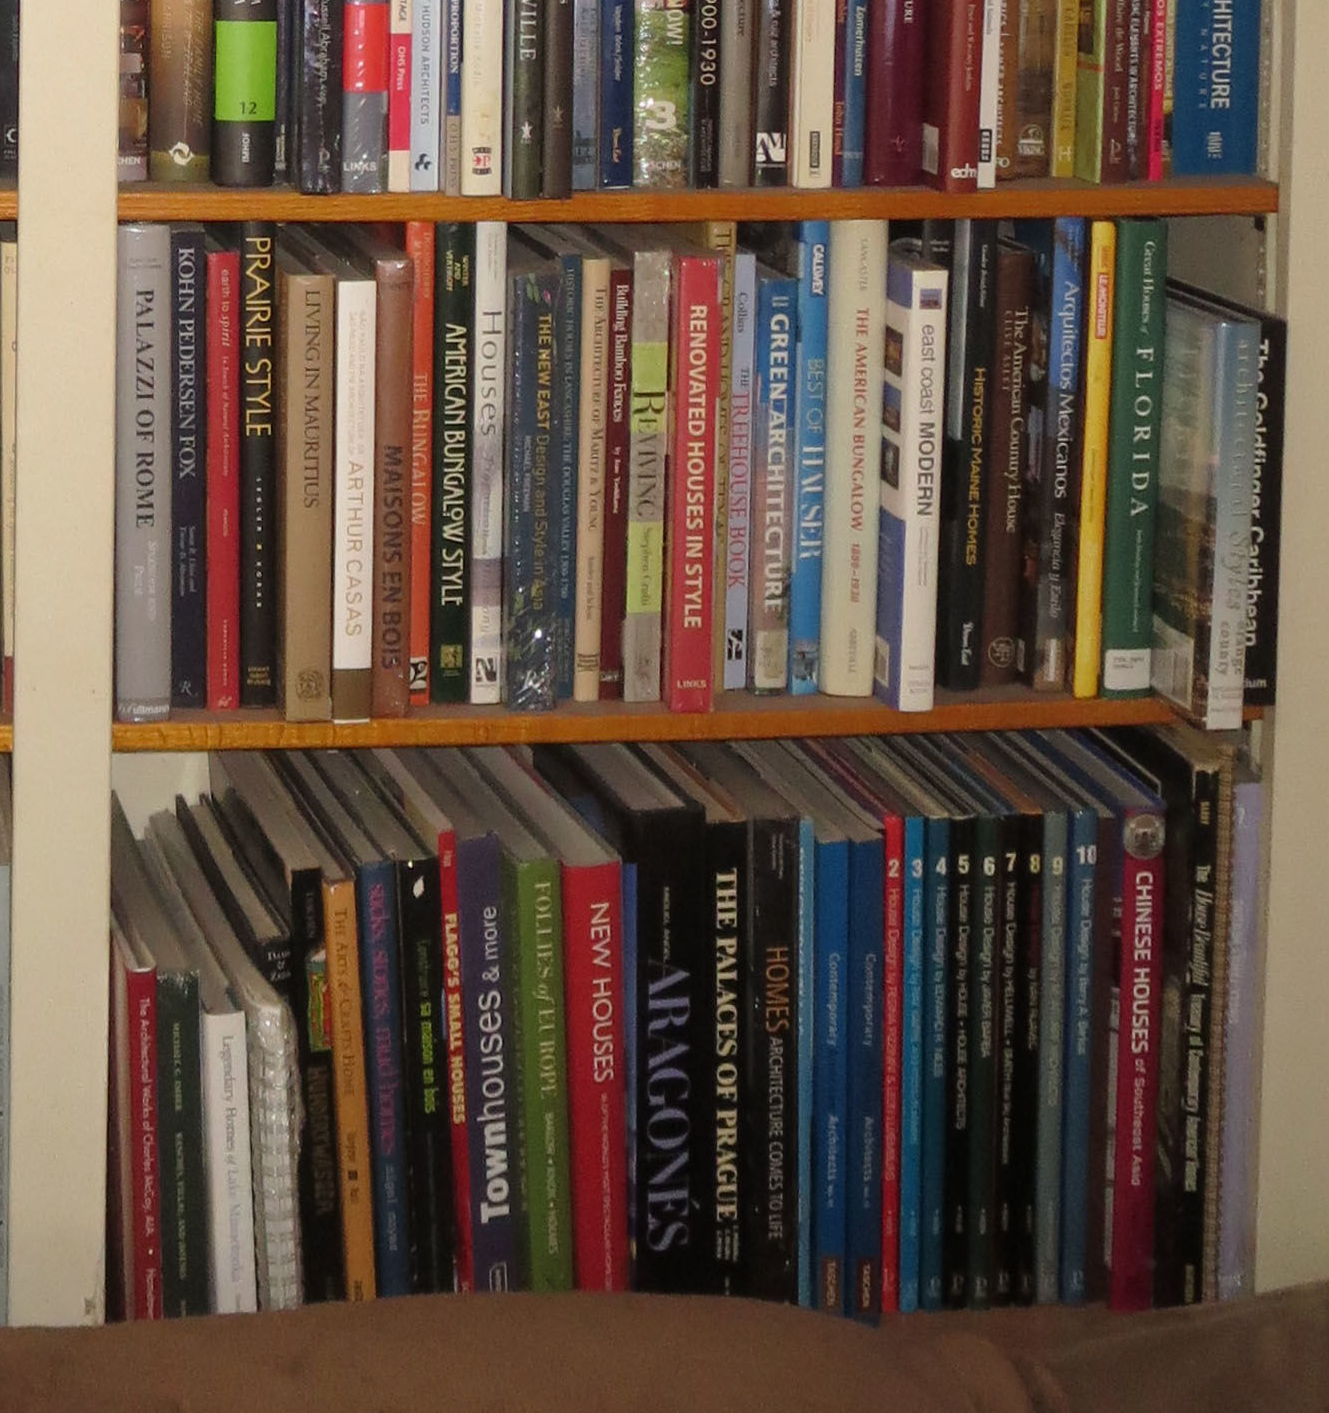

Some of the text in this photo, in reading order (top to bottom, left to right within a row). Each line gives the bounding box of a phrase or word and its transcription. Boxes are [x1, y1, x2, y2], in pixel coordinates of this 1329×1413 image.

[421, 5, 431, 51] HUDSON
[421, 55, 430, 124] ARCHITECTS
[135, 290, 154, 528] PALAZZI OF ROME
[177, 247, 196, 478] KOHN PEDERSEN FOX
[245, 238, 271, 436] PRAIRIE STYLE
[917, 325, 934, 516] east coast MODERN
[441, 324, 466, 605] AMERICAN BUNGALOW STYLE
[684, 305, 707, 627] RENOVATED HOUSES IN STYLE
[591, 903, 611, 967] NEW
[593, 978, 613, 1082] HOUSES
[716, 868, 736, 1221] THE PALACES OF PRAGUE
[1132, 871, 1153, 1185] CHINESE HOUSES of Southeast Asia
[480, 907, 509, 1224] Townhouses & more
[646, 958, 699, 1251] ARAGONÉS
